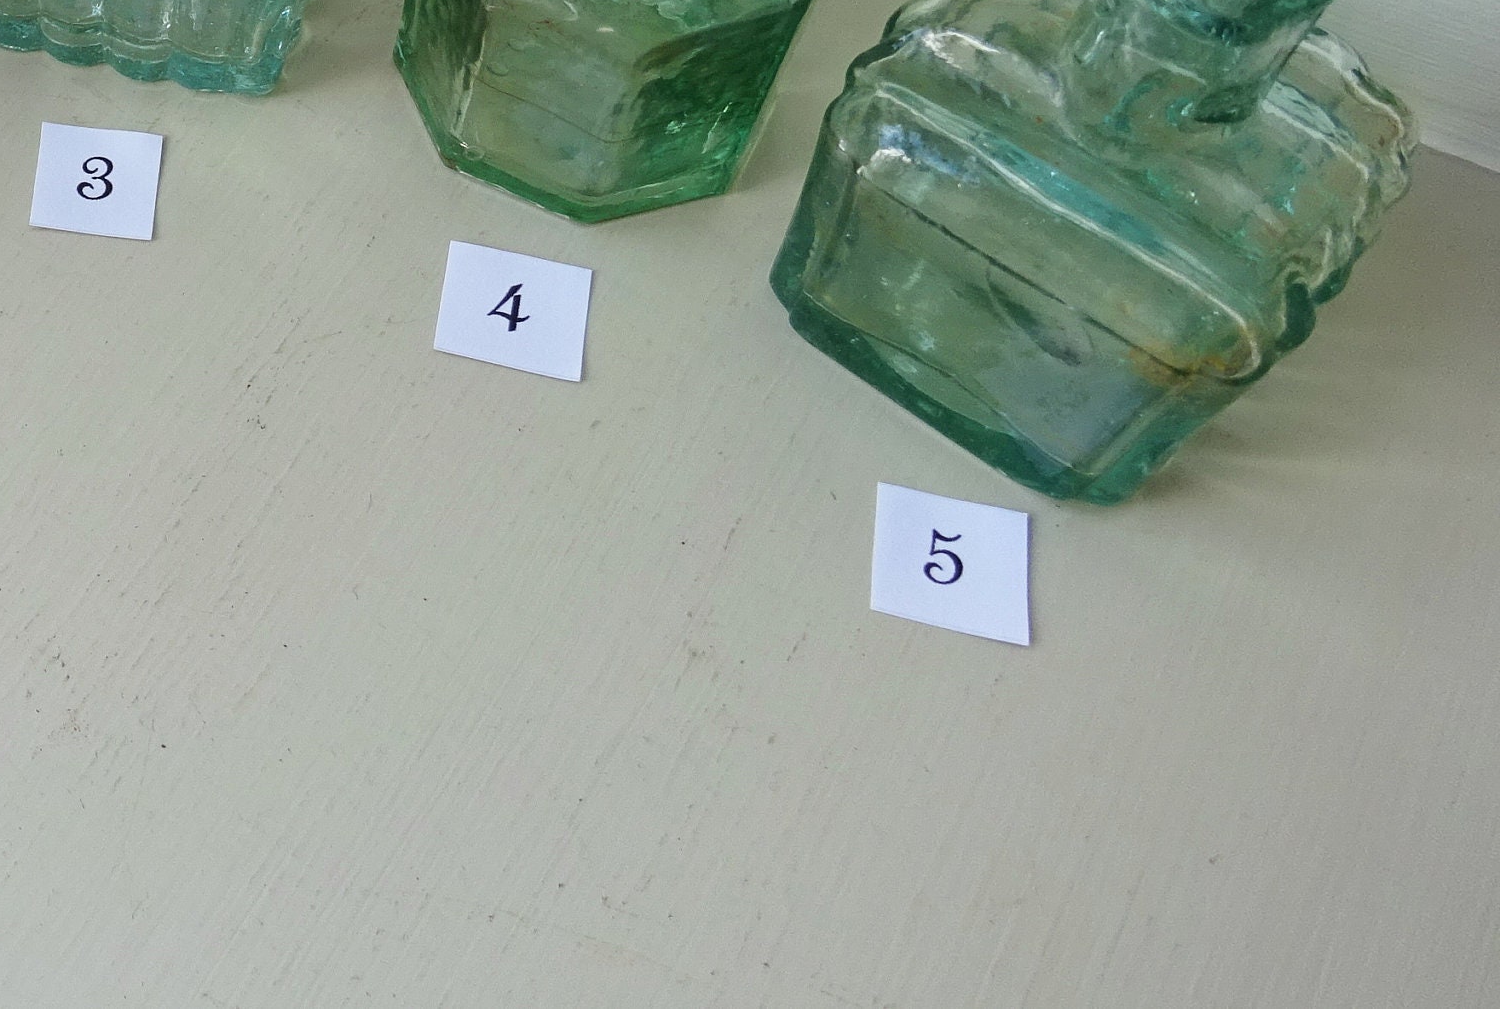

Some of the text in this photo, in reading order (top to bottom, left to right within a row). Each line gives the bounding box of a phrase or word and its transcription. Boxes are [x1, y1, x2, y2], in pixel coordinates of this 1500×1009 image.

[75, 156, 114, 201] 3
[485, 283, 531, 332] 4
[923, 528, 964, 586] 5
